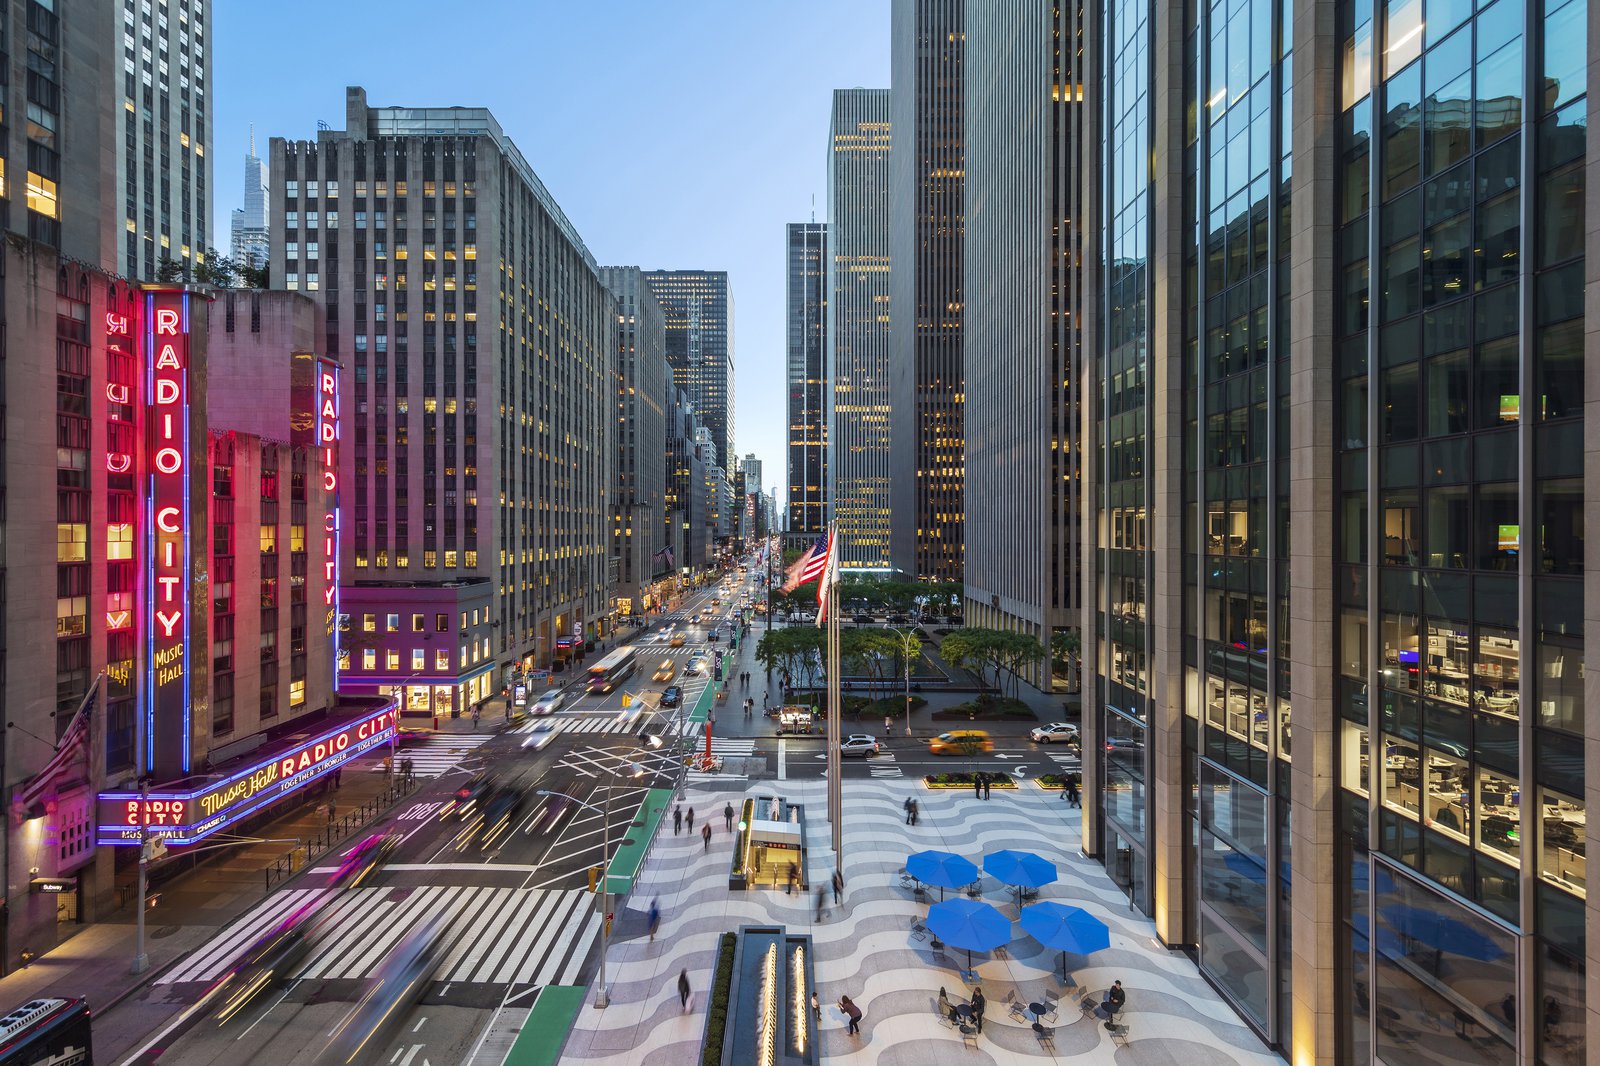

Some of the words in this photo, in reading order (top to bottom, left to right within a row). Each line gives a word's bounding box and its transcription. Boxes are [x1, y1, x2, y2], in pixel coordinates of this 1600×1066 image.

[156, 309, 182, 474] RADIO
[322, 373, 337, 491] RADIO
[156, 507, 182, 637] CITY
[154, 643, 184, 669] MUSIC
[159, 663, 184, 687] HALL
[196, 817, 220, 834] CHASE
[280, 769, 314, 792] TOGETHER
[317, 753, 347, 773] STRONGER
[357, 735, 383, 752] TOGETHER
[201, 780, 247, 816] Music
[243, 762, 278, 799] Hall
[281, 733, 349, 778] RADIO
[358, 708, 398, 740] CITY
[127, 813, 183, 825] CITY
[159, 830, 185, 839] HALL
[397, 801, 444, 821] BUS
